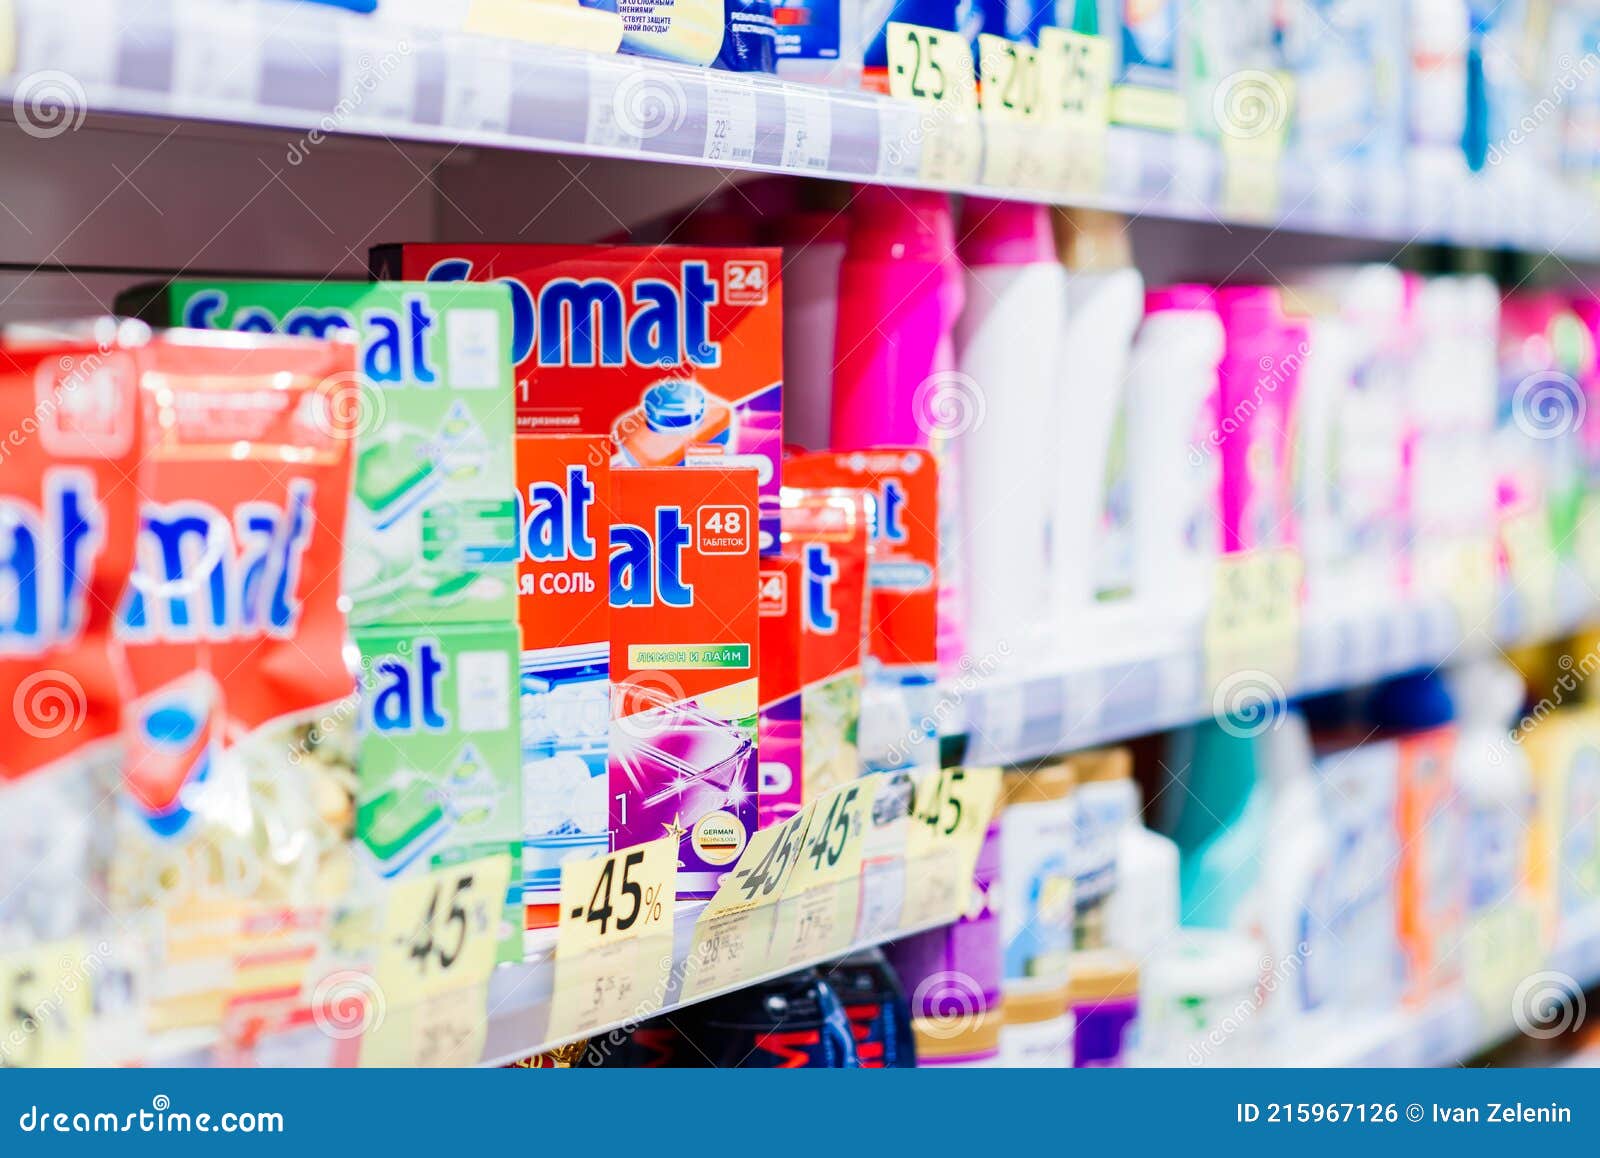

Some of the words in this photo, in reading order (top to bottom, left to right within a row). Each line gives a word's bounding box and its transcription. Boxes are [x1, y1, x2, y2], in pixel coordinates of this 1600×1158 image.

[621, 15, 646, 23] СТВУЕТ
[728, 267, 763, 289] 24
[425, 257, 721, 369] omat
[705, 512, 741, 534] 48
[703, 537, 744, 547] ТАБЛЕТОК
[539, 572, 595, 594] СОЛЬ
[759, 576, 783, 601] 4
[637, 652, 686, 663] ЛИМОН
[690, 651, 698, 662] И
[703, 650, 742, 662] ЛАЙМ
